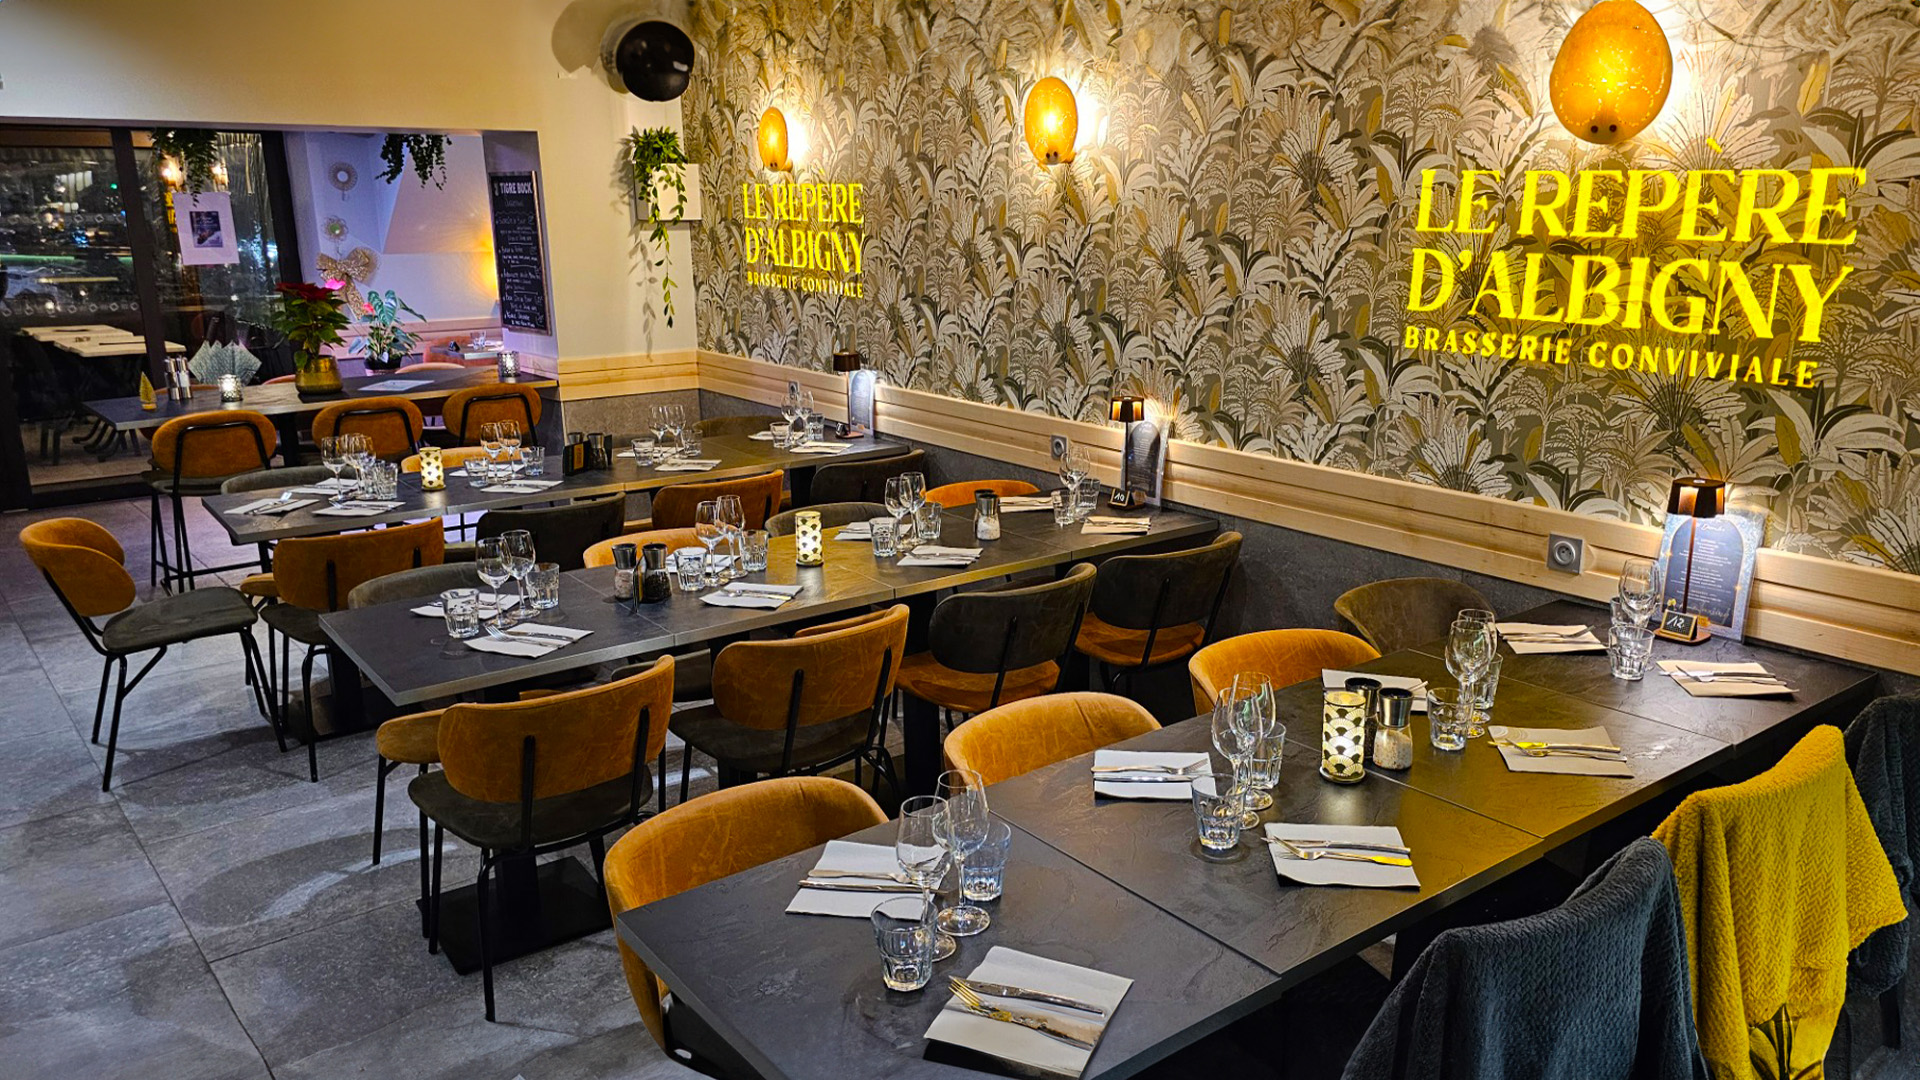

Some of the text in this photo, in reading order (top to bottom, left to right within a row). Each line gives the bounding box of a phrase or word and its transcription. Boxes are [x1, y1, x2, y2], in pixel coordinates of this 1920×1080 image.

[499, 182, 533, 194] TIGRE BOCK
[742, 183, 769, 219] LE
[1414, 136, 1867, 246] LE REPÈRE
[744, 226, 866, 274] D'ALBIGNY
[746, 271, 864, 299] BRASSERIE CONVIVIALE
[1405, 248, 1855, 343] D'ALBIGNY
[1403, 326, 1818, 389] BRASSERIE CONVIVIALE
